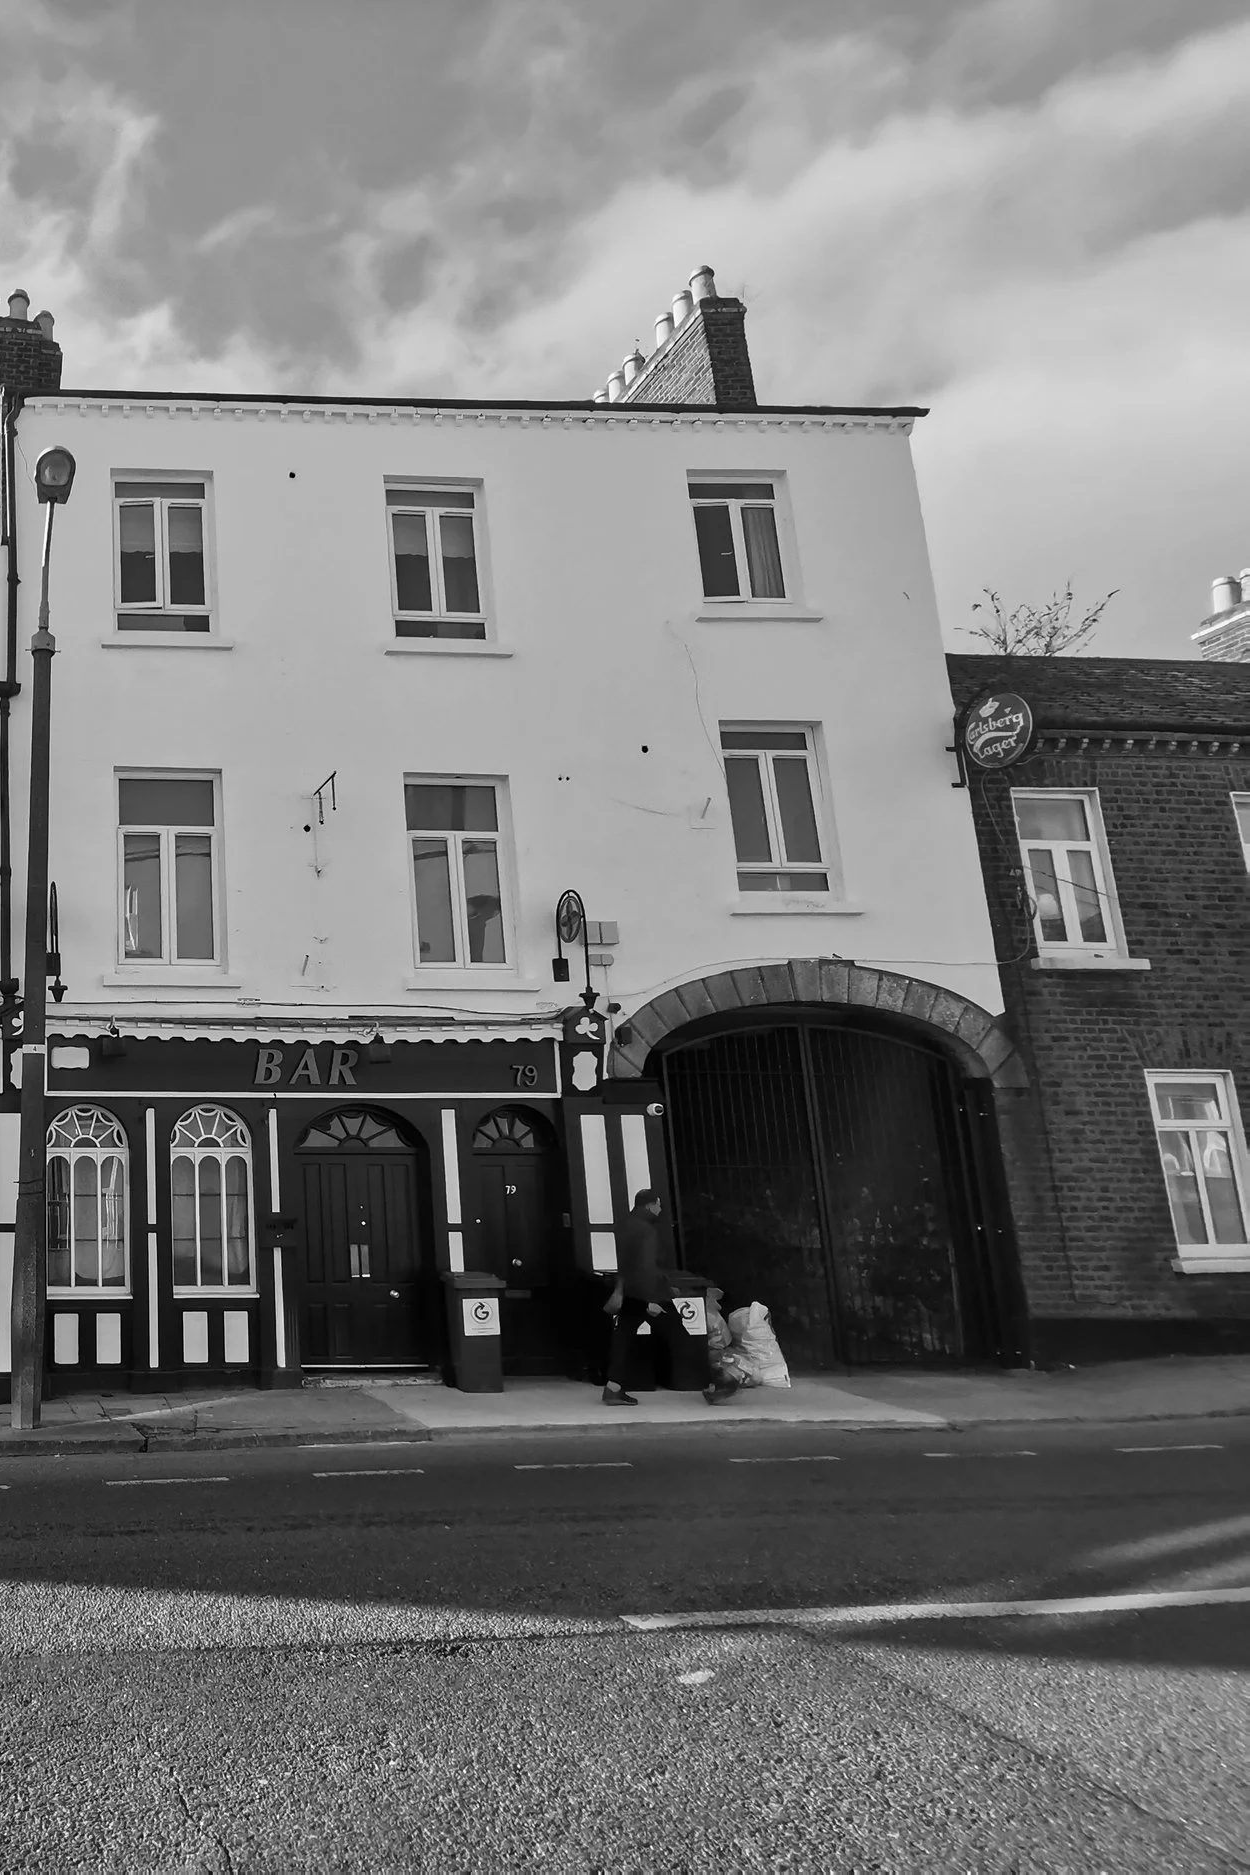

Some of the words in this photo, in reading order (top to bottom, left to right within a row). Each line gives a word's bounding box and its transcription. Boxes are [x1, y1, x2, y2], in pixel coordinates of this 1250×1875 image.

[967, 712, 1024, 745] Carlsberg
[973, 733, 1017, 758] Lager
[253, 1048, 359, 1086] BAR
[512, 1065, 538, 1086] 79
[505, 1185, 517, 1195] 79
